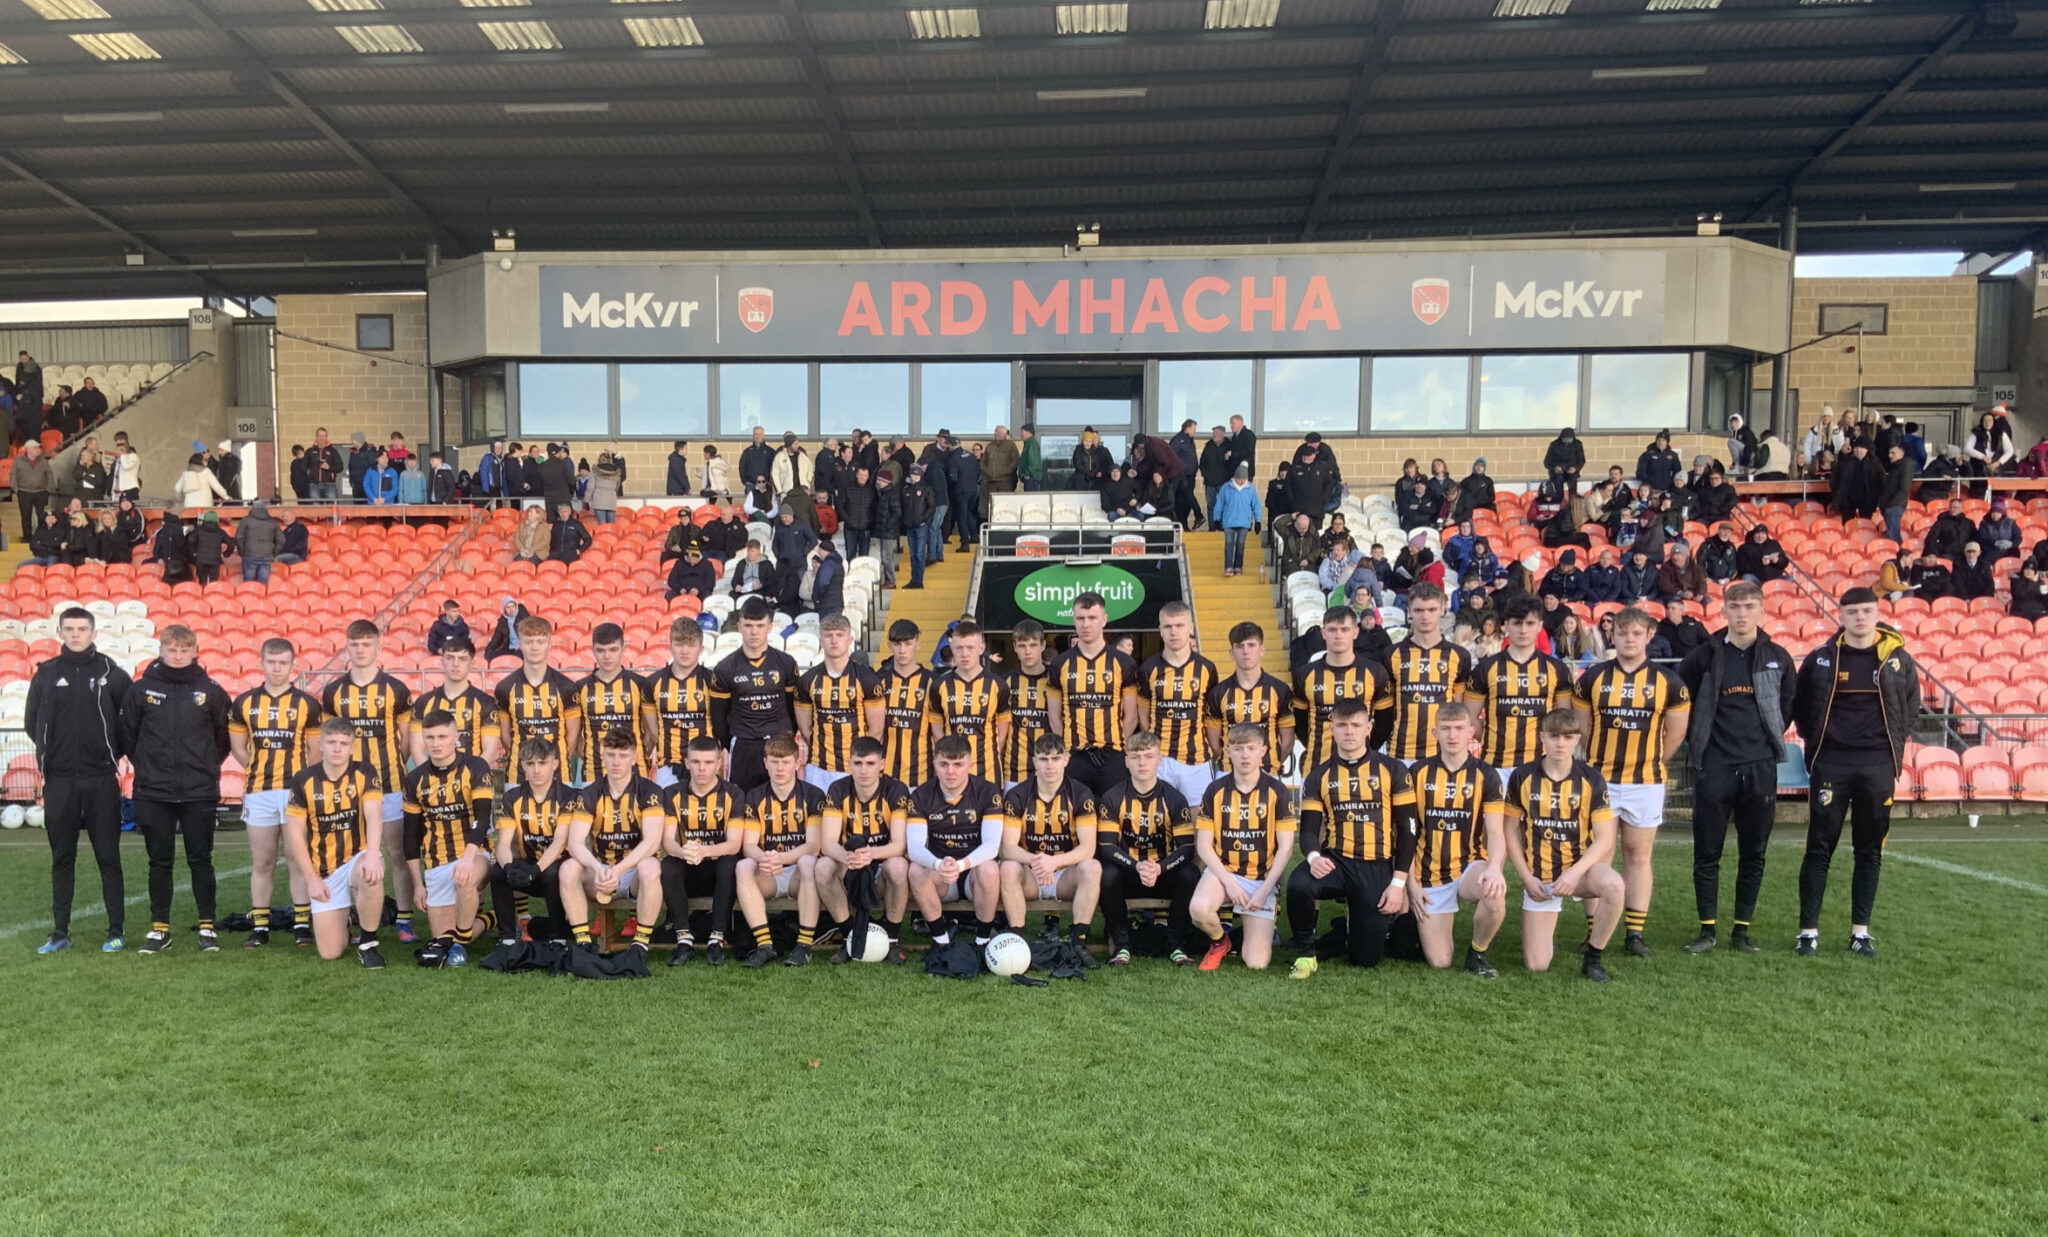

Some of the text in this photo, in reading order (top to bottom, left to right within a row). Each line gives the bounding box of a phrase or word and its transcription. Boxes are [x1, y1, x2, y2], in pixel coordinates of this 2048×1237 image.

[1494, 280, 1643, 318] McKvr
[562, 292, 698, 328] McKvr
[837, 275, 1342, 337] ARD MHACHA
[194, 314, 211, 324] 108
[1994, 390, 2014, 400] 105
[238, 424, 256, 433] 108
[1419, 664, 1430, 674] 24
[752, 676, 765, 687] 16
[1087, 674, 1094, 684] 9
[1518, 678, 1529, 688] 10
[1174, 682, 1184, 692] 15
[1336, 686, 1343, 696] 6
[832, 691, 838, 700] 3
[900, 691, 906, 699] 4
[1028, 691, 1036, 700] 13
[1621, 688, 1635, 698] 28
[604, 696, 615, 706] 22
[677, 695, 688, 703] 27
[1243, 704, 1253, 714] 26
[1600, 708, 1652, 718] HANRATTY
[1351, 782, 1358, 792] 7
[334, 794, 341, 803] 5
[1333, 802, 1381, 811] HANRATTY
[1238, 810, 1250, 820] 20
[1426, 809, 1471, 819] HANRATTY
[782, 816, 787, 825] 2
[864, 817, 870, 826] 8
[951, 815, 956, 825] 1
[932, 832, 979, 840] HANRATTY
[1222, 830, 1266, 838] HANRATTY
